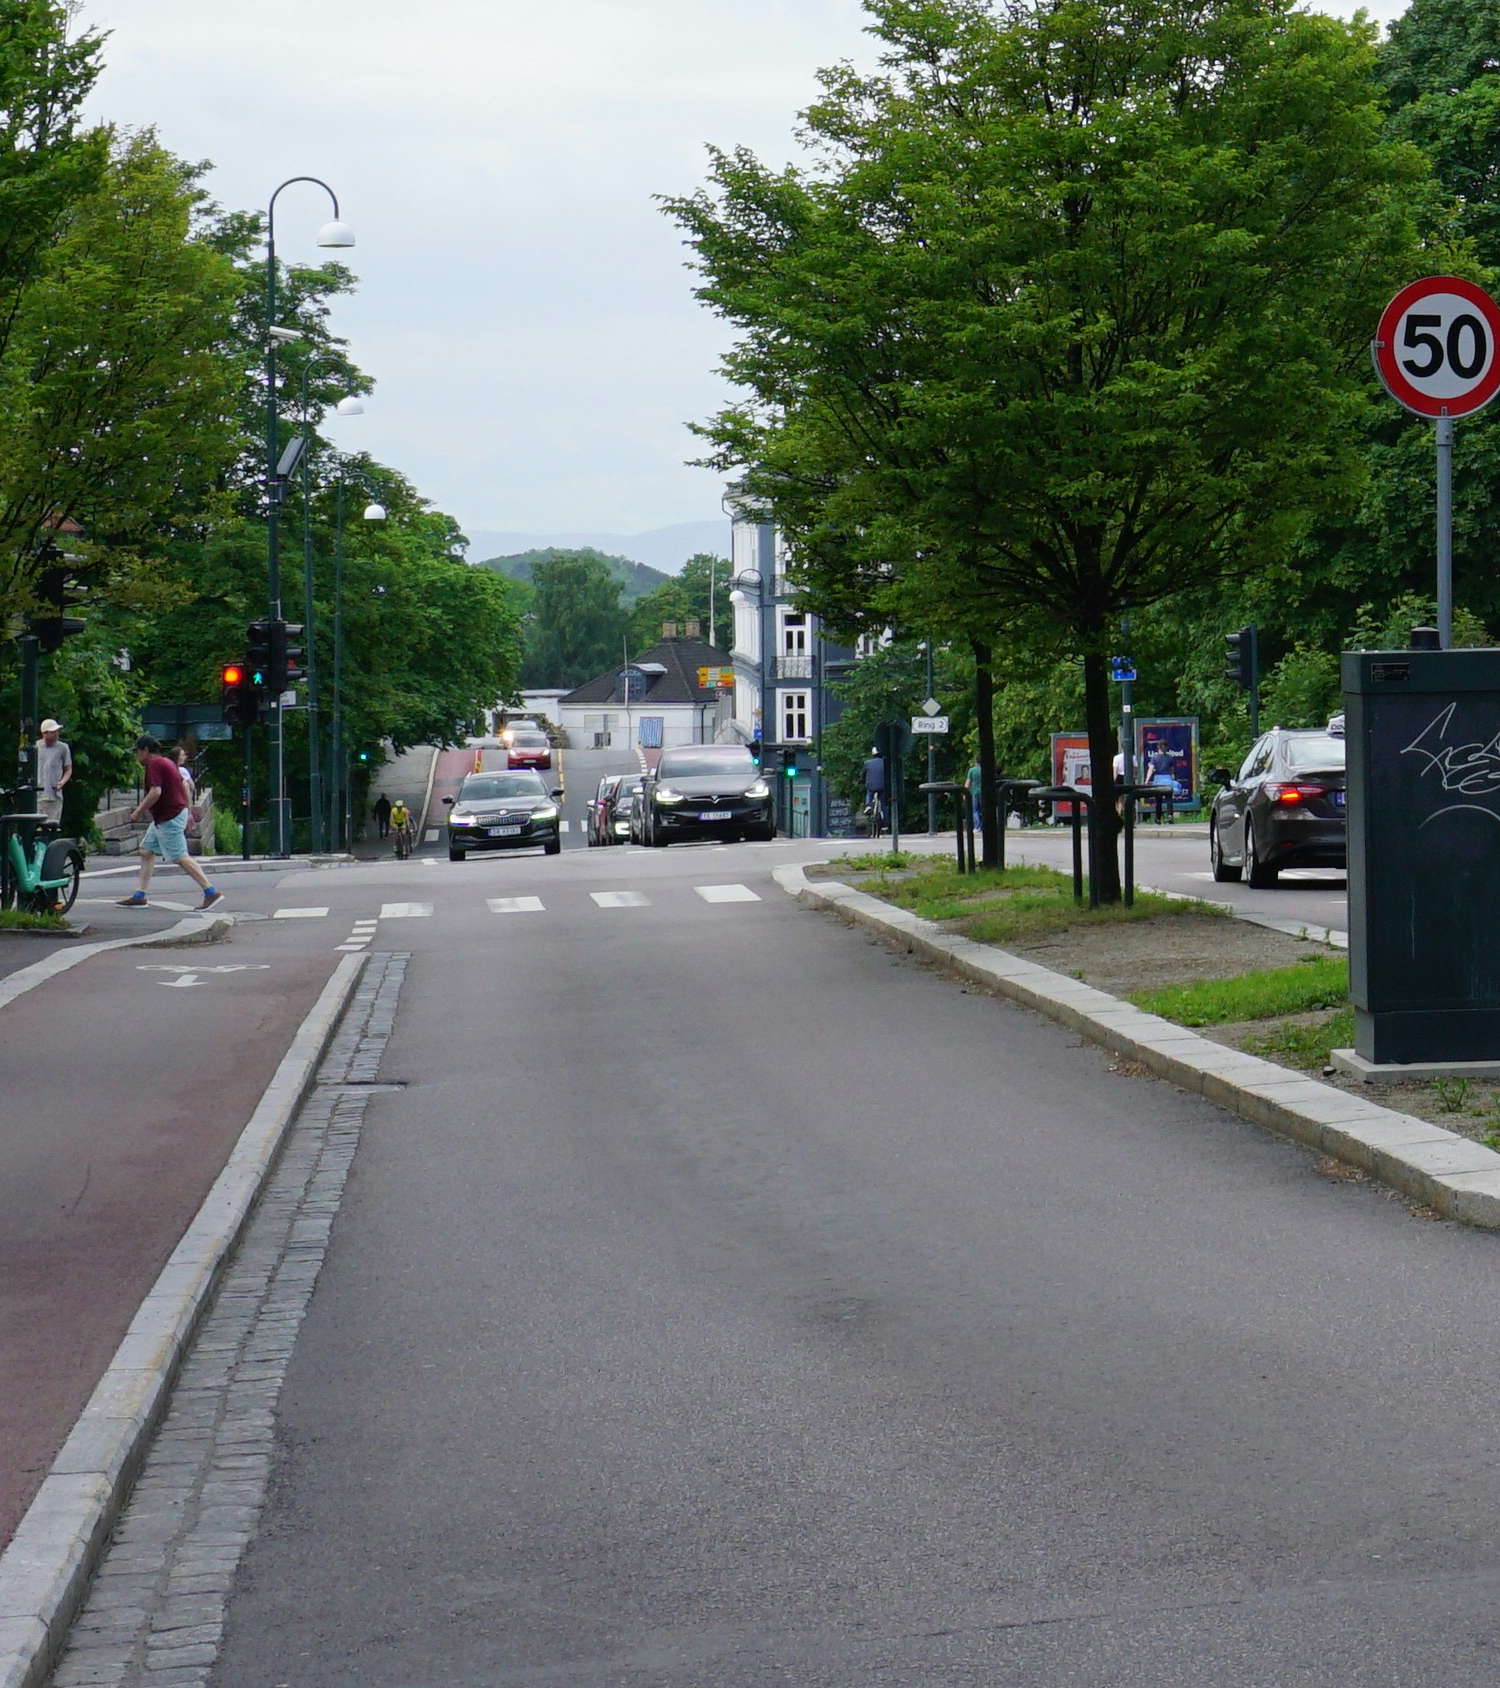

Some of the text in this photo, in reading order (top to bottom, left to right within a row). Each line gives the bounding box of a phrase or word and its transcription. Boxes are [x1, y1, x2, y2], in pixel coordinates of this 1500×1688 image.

[1402, 313, 1489, 380] 50
[917, 721, 945, 730] Ring 2
